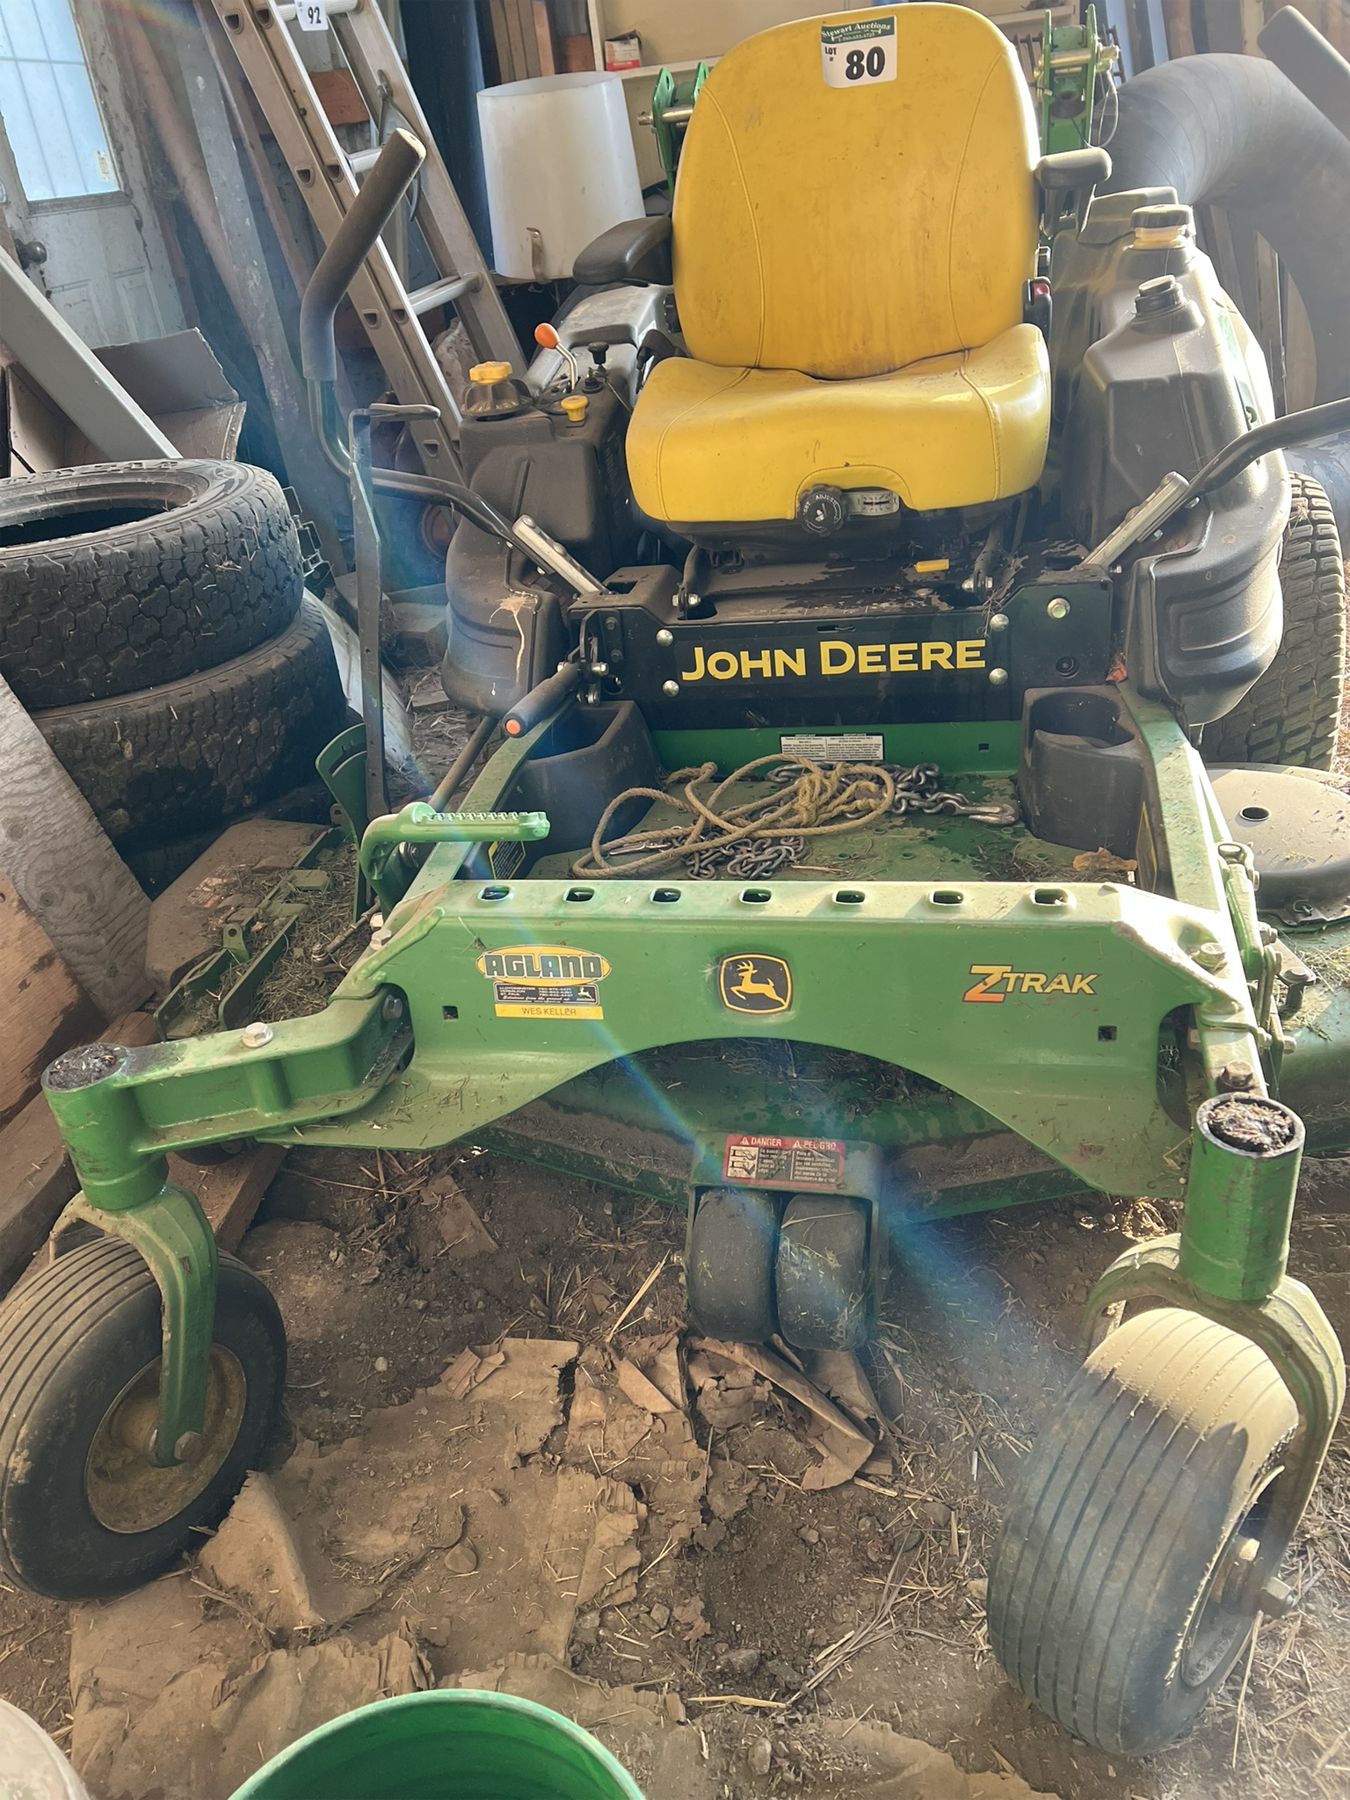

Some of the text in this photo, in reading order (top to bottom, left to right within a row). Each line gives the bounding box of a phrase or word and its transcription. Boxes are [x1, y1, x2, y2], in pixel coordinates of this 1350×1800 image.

[307, 6, 322, 24] 92
[854, 22, 891, 31] Auctions
[824, 46, 837, 55] LOT
[845, 46, 886, 80] 80
[681, 639, 986, 681] JOHN DEERE
[484, 954, 603, 978] AGLAND
[521, 1007, 577, 1016] WES KELLER
[751, 1137, 782, 1147] DANGER
